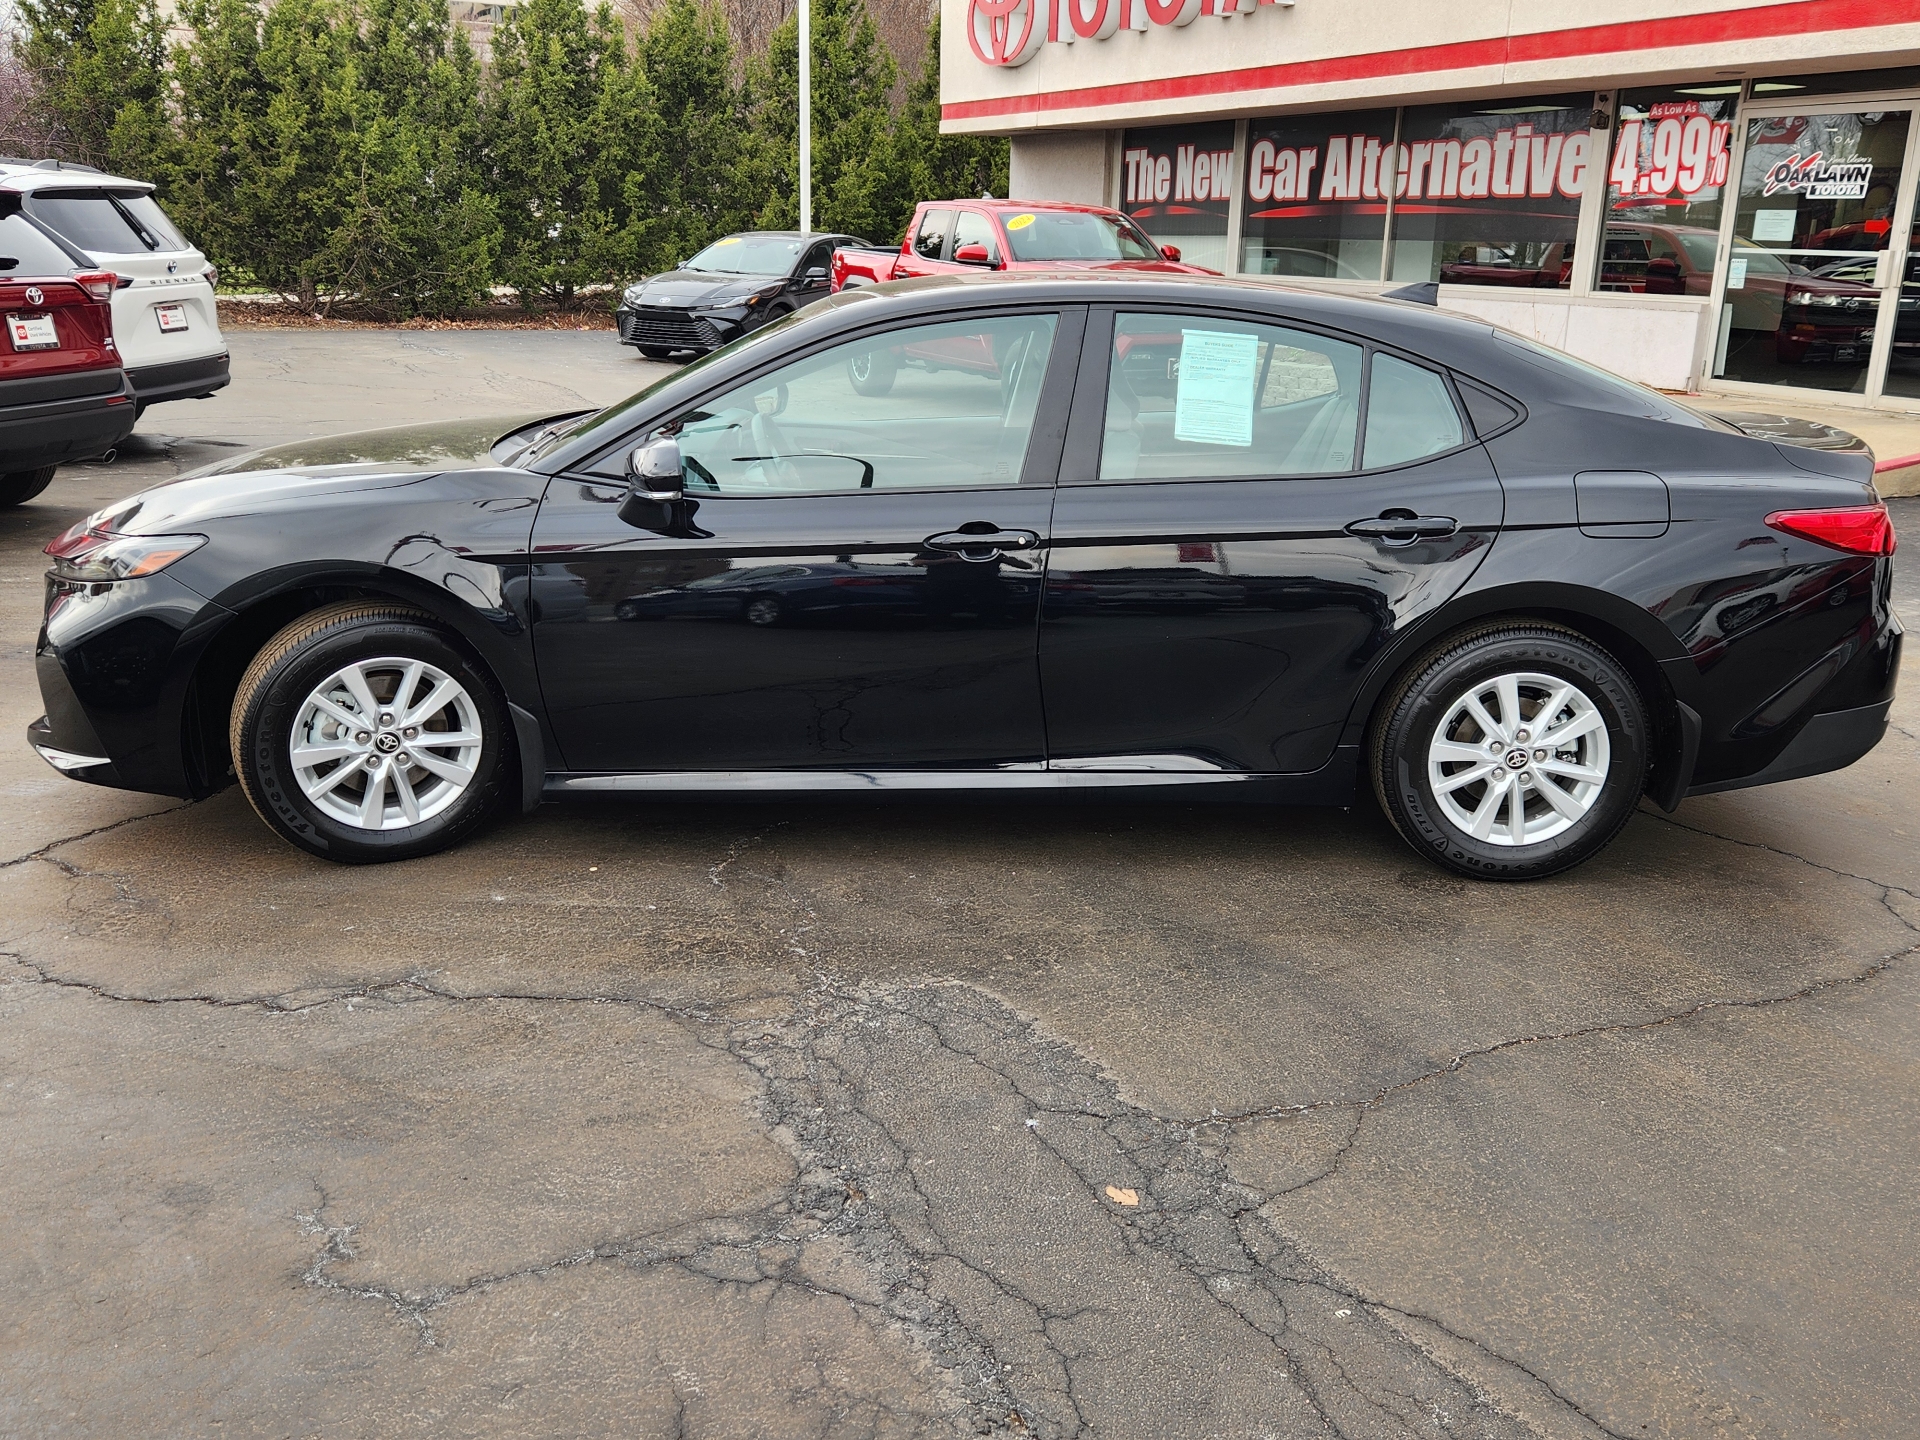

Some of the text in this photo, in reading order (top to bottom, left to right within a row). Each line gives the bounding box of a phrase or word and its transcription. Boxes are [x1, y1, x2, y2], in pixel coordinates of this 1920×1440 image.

[1651, 102, 1697, 116] As Low As
[1126, 122, 1590, 201] The New Car Alternative
[1609, 113, 1730, 196] 4.99%
[1813, 184, 1862, 195] TOYOTA
[1459, 645, 1590, 674] Firestone
[258, 713, 309, 834] Firestone
[1407, 794, 1433, 834] FT140
